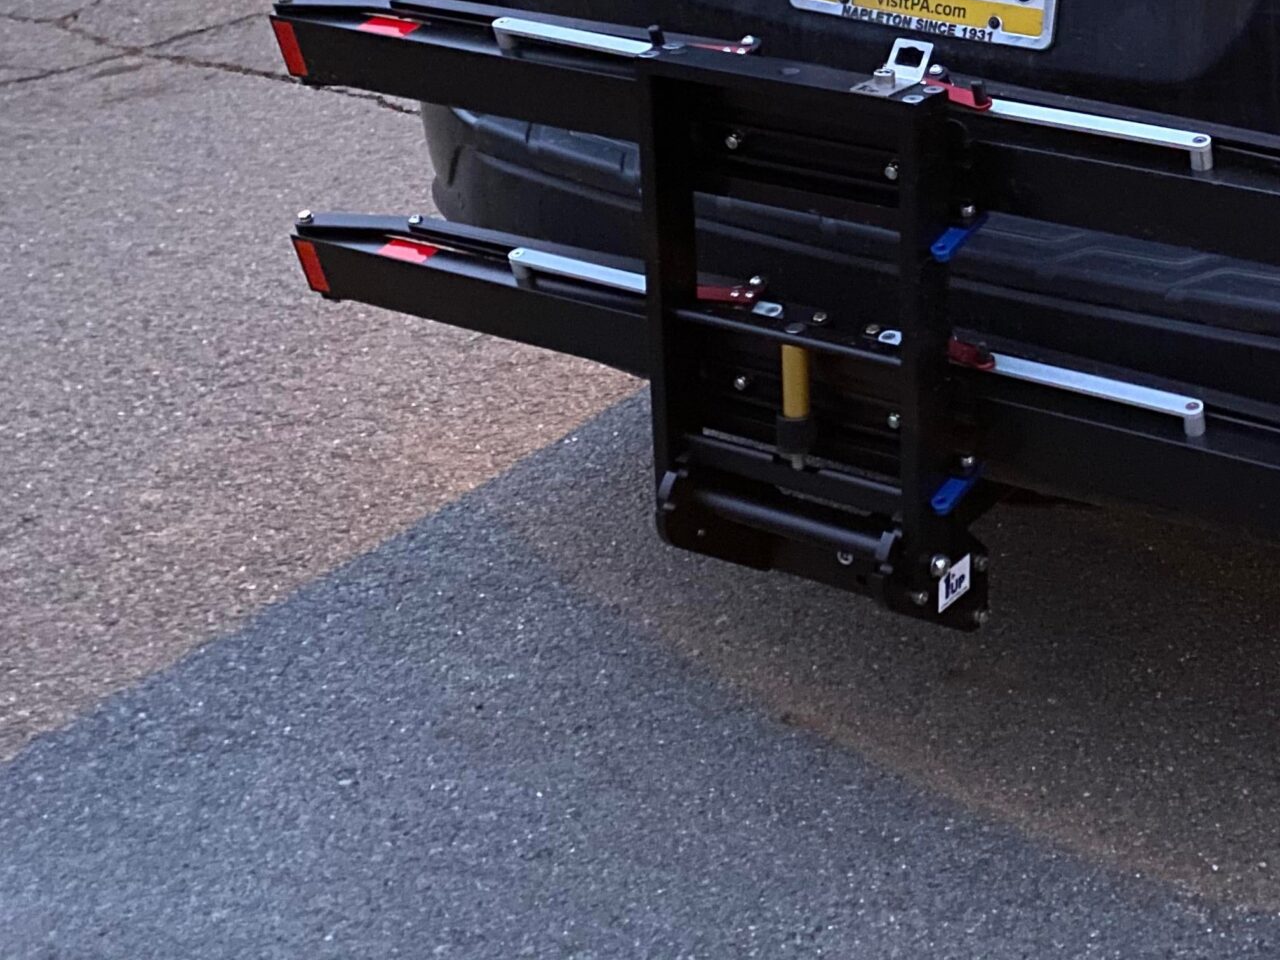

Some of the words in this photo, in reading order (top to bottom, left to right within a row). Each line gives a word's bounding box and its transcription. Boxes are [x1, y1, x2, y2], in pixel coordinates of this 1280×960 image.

[841, 4, 913, 29] NAPLETON
[915, 17, 957, 35] SINCE
[960, 25, 994, 42] 1931
